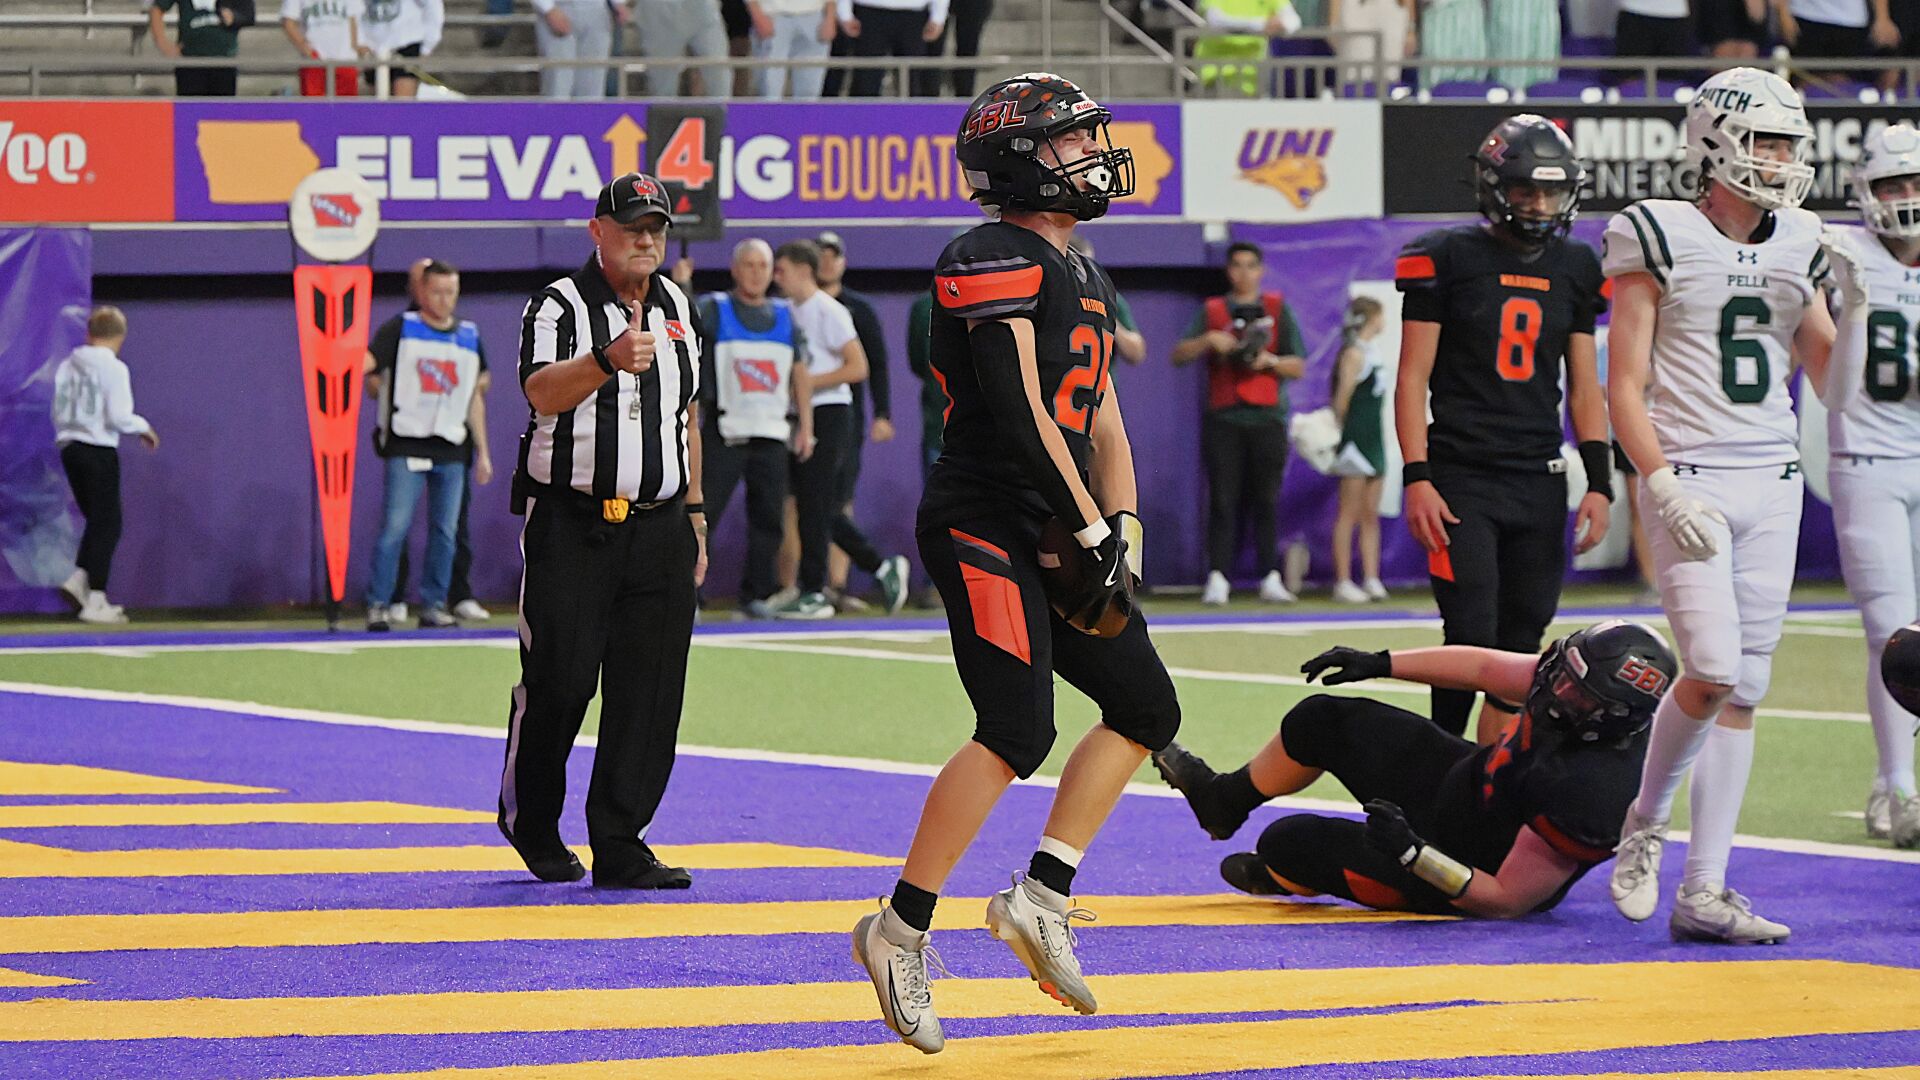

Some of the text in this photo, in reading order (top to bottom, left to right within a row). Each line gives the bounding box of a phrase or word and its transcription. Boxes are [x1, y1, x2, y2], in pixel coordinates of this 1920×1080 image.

[965, 101, 1026, 144] SBL
[1238, 128, 1334, 170] UNI
[656, 116, 714, 189] 4
[800, 134, 975, 201] EDUCAT
[1578, 161, 1699, 200] ENERG
[1728, 275, 1769, 288] PELLA
[1496, 297, 1542, 382] 8
[1720, 296, 1771, 403] 6
